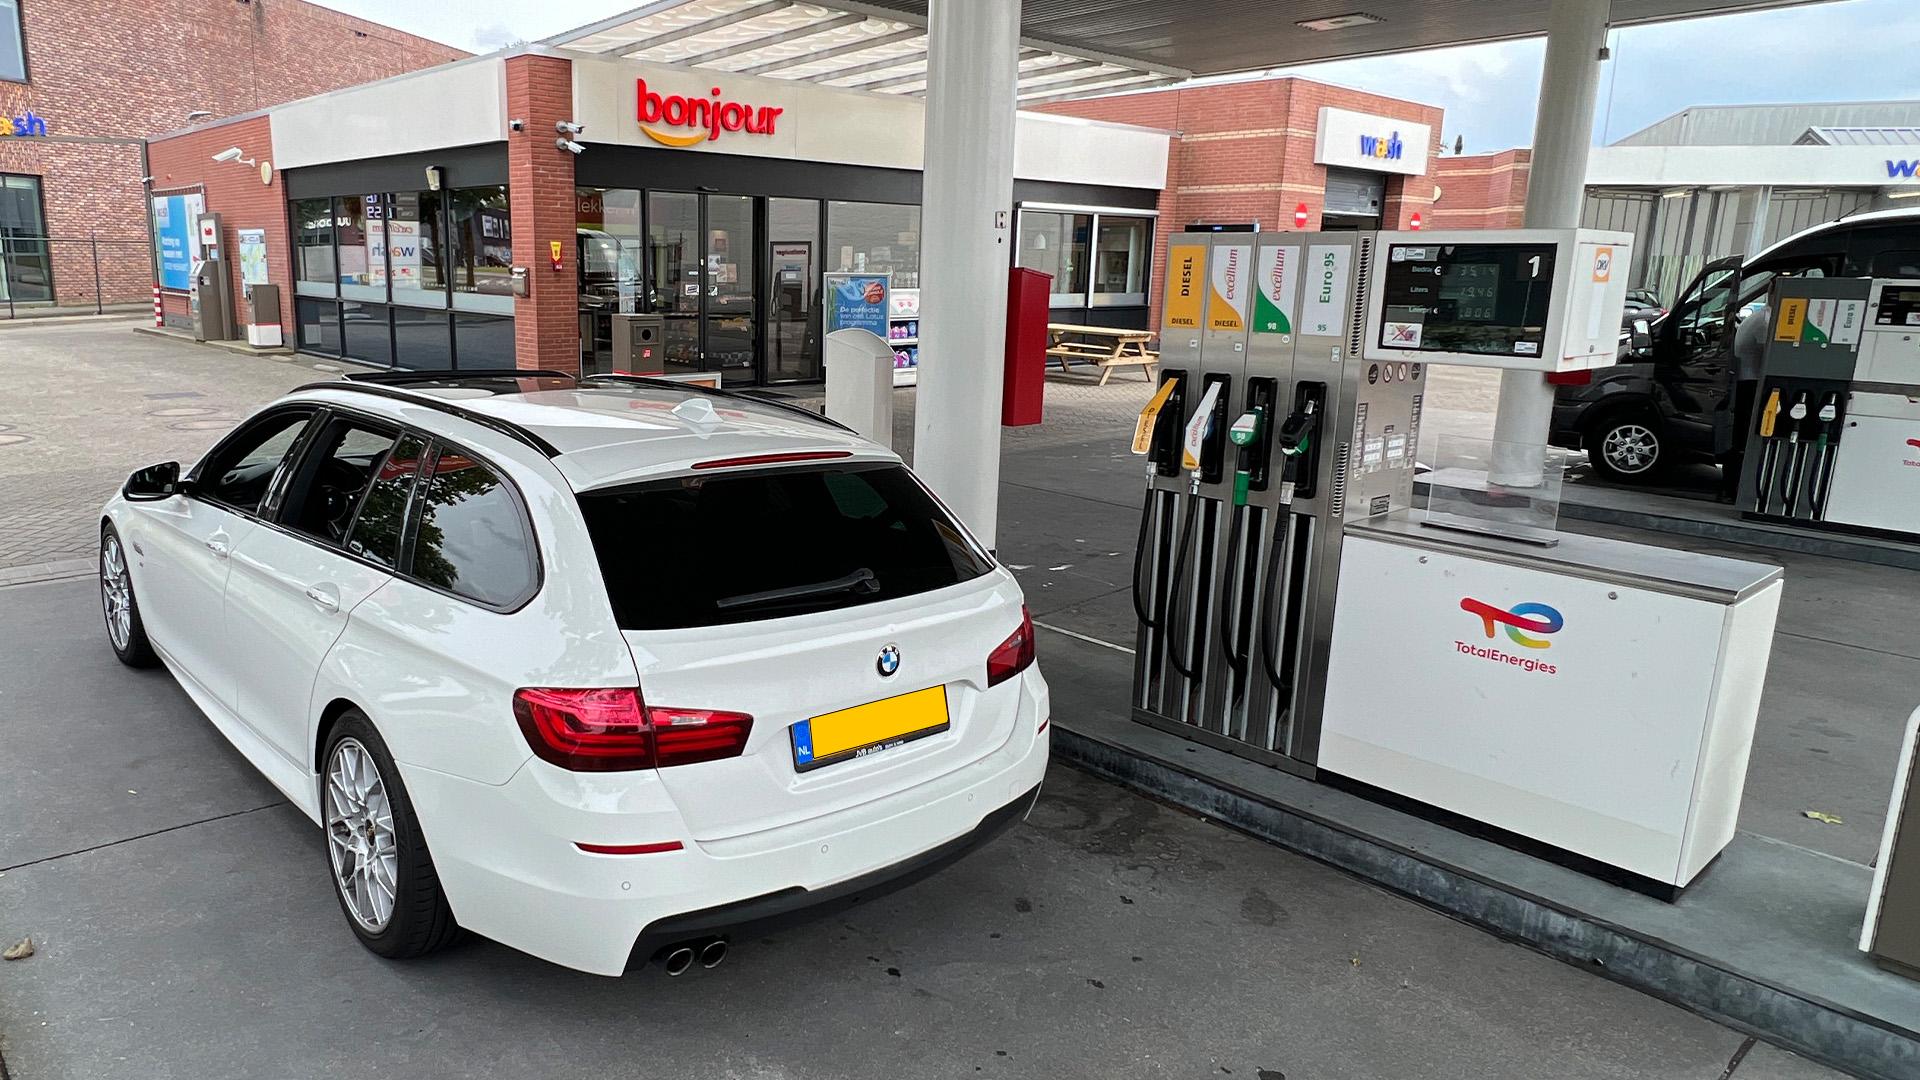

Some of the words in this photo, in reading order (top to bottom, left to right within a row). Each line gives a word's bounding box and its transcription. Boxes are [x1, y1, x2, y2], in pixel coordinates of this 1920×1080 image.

[637, 78, 783, 141] bonjour
[1360, 131, 1403, 160] wash
[1886, 159, 1920, 178] w
[1324, 252, 1336, 269] 95
[1528, 255, 1541, 278] 1
[1180, 256, 1193, 297] DIESEL
[1226, 248, 1239, 300] excellium
[1272, 248, 1286, 302] excellium
[1319, 270, 1333, 304] Euro
[1171, 317, 1194, 326] DIESEL
[1214, 319, 1239, 329] DIESEL
[1266, 322, 1277, 331] 98
[1317, 324, 1327, 332] 95
[1454, 640, 1557, 675] TotalEnergies
[798, 745, 810, 756] NL
